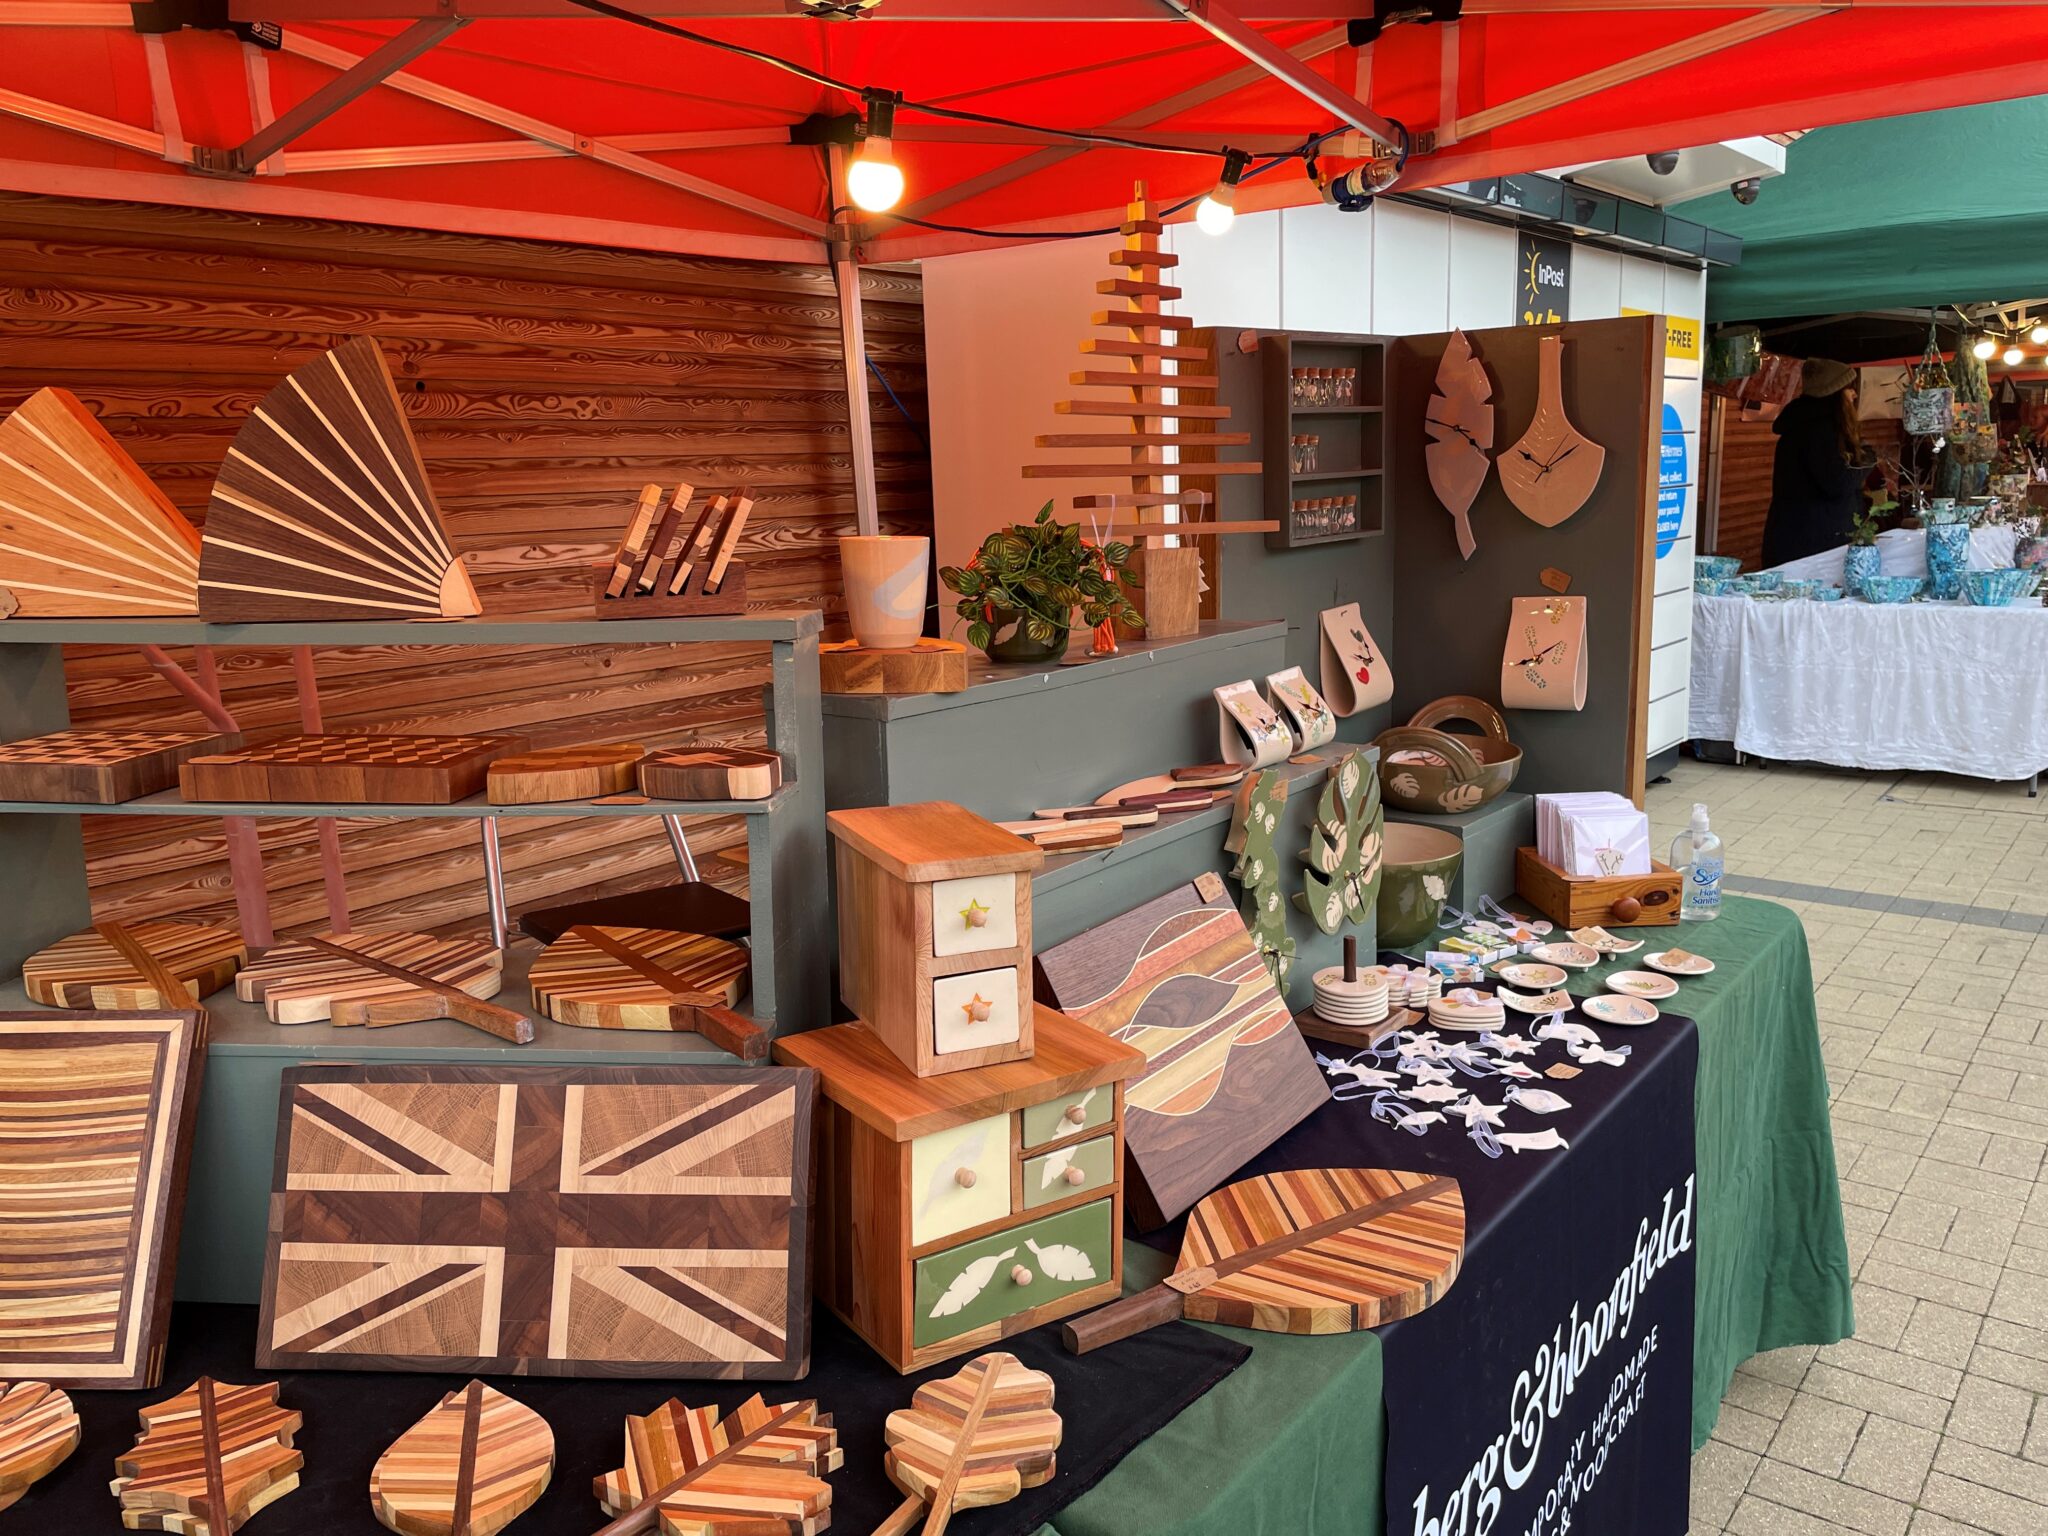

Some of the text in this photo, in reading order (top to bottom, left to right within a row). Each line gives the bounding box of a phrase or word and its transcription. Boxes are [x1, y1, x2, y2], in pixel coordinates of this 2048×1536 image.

[1538, 263, 1564, 287] InPost
[1666, 328, 1692, 349] -FREE
[1592, 1324, 1658, 1446] HANDMADE
